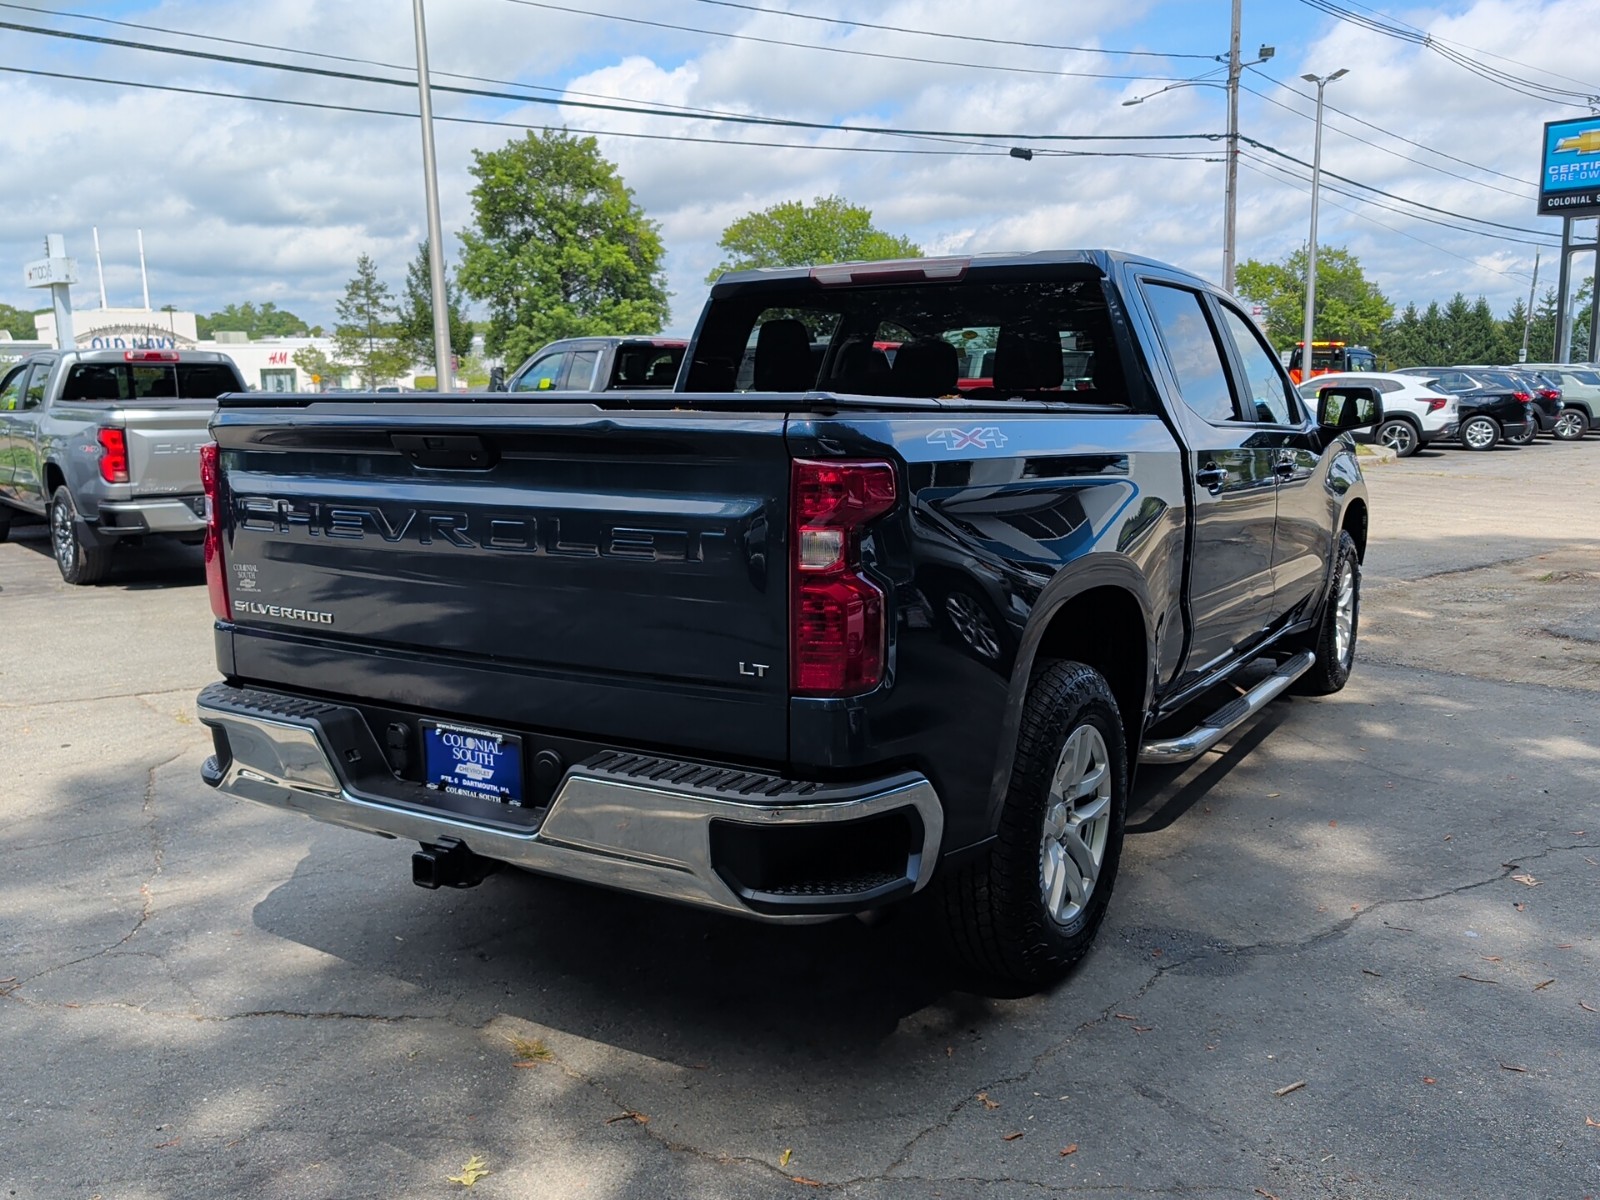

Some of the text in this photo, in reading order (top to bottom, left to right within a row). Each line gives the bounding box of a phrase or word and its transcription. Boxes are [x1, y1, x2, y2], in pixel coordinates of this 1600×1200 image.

[1547, 196, 1591, 206] COLONIAL
[91, 335, 175, 349] OLD NAVY
[239, 498, 726, 563] CHEVROLET
[234, 600, 334, 624] SILVERADO
[739, 661, 770, 677] LT
[443, 733, 503, 755] COLONIAL
[453, 747, 495, 766] SOUTH
[458, 765, 491, 777] CHEVROLET
[445, 786, 501, 803] COLONIAL SOUTH
